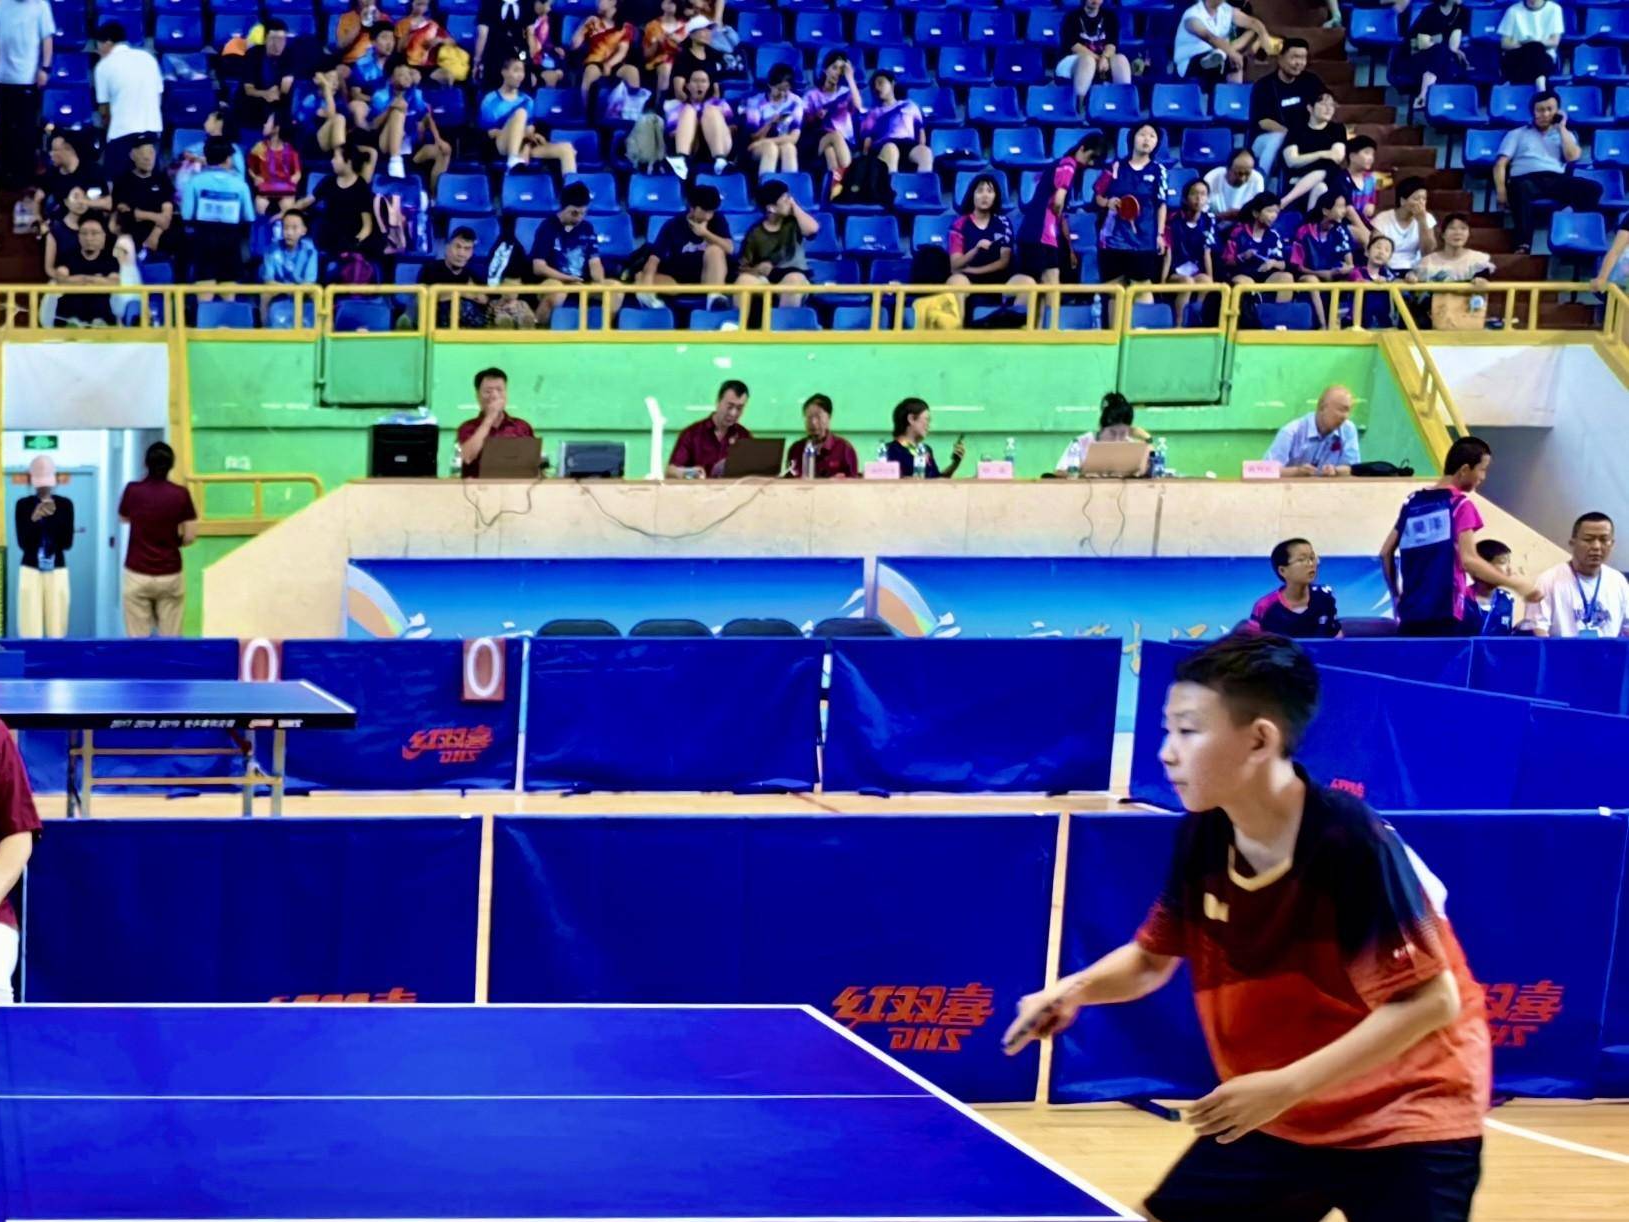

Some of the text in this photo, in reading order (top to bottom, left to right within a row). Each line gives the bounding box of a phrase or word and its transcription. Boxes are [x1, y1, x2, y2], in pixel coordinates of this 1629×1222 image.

[466, 637, 502, 698] 0
[831, 982, 995, 1029] 红双喜
[887, 1027, 973, 1051] DHS
